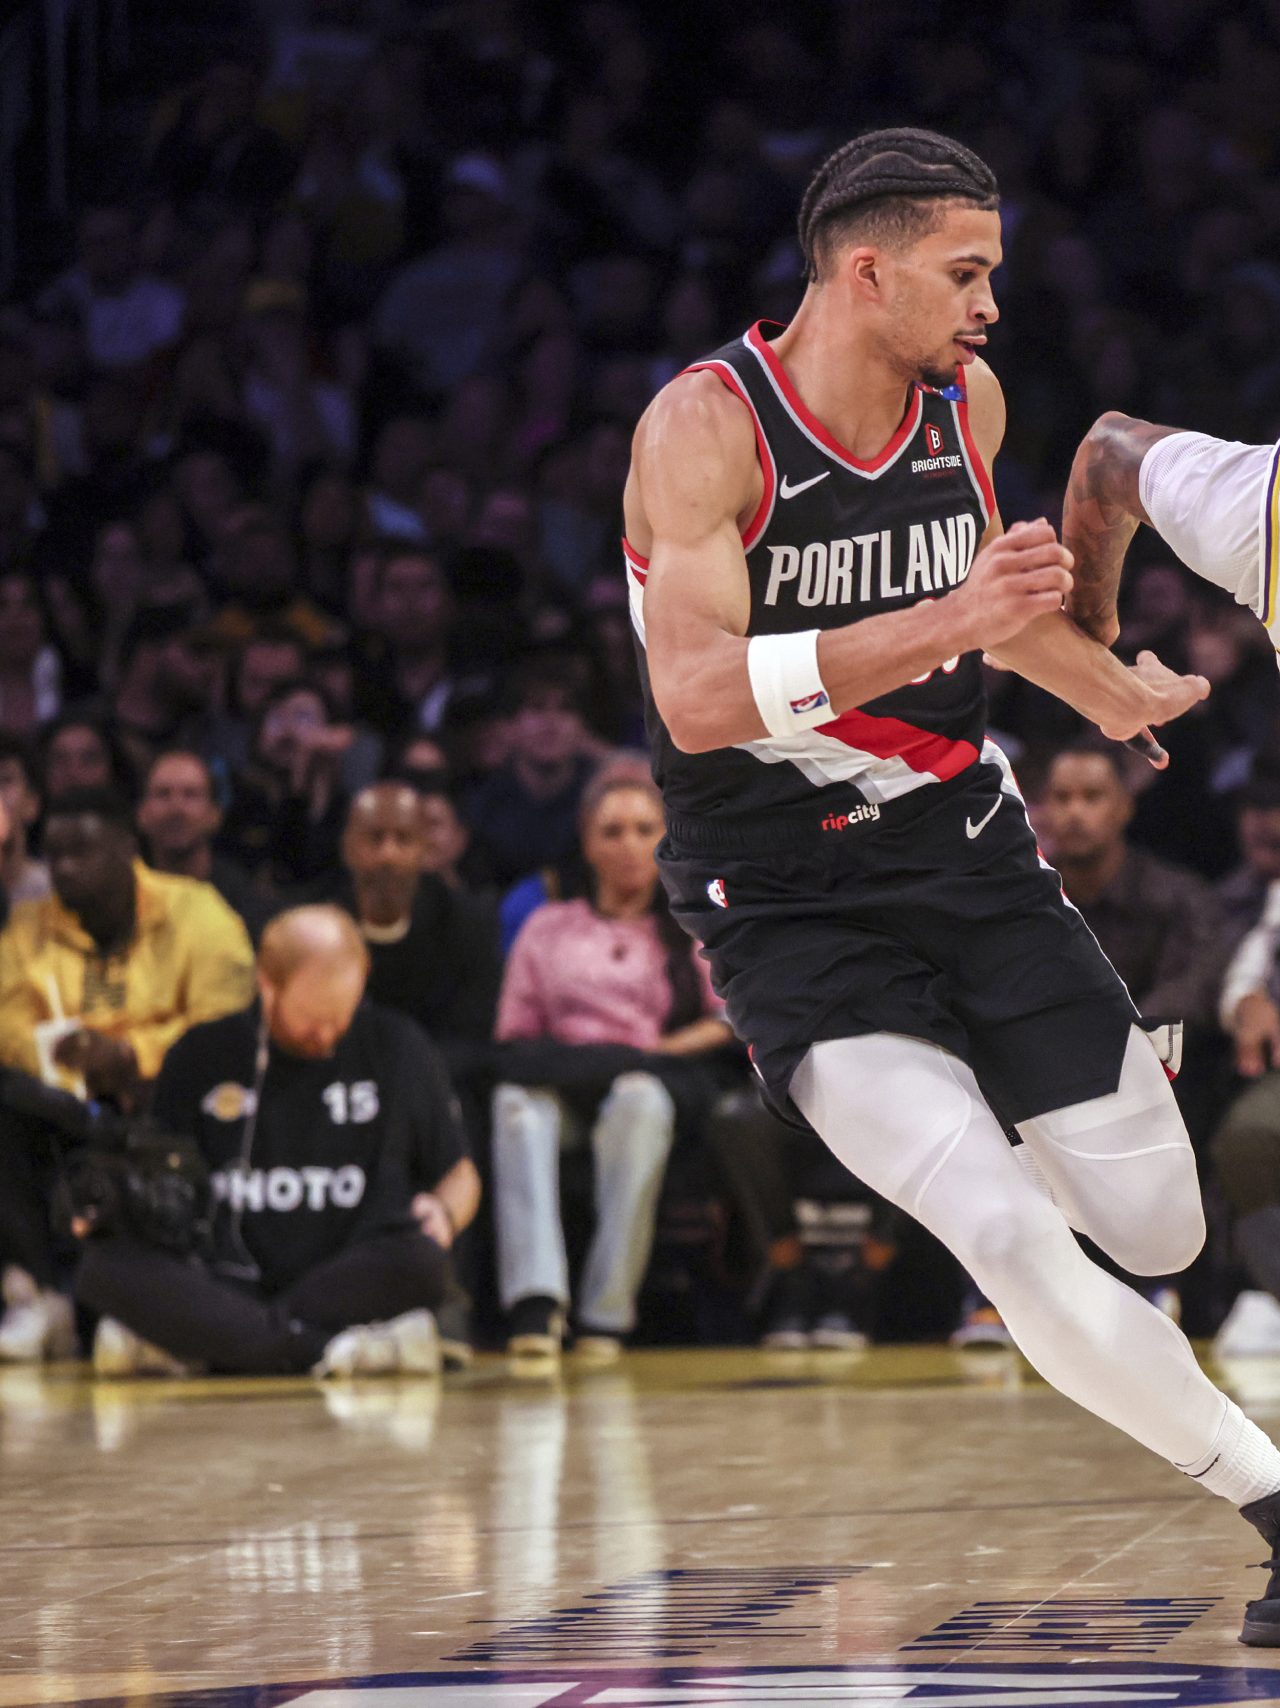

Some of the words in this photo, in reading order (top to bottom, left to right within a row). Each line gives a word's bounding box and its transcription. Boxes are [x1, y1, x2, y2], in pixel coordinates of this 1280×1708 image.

[911, 455, 963, 474] BRIGHTSIDE
[764, 512, 978, 608] PORTLAND
[322, 1080, 380, 1125] 15
